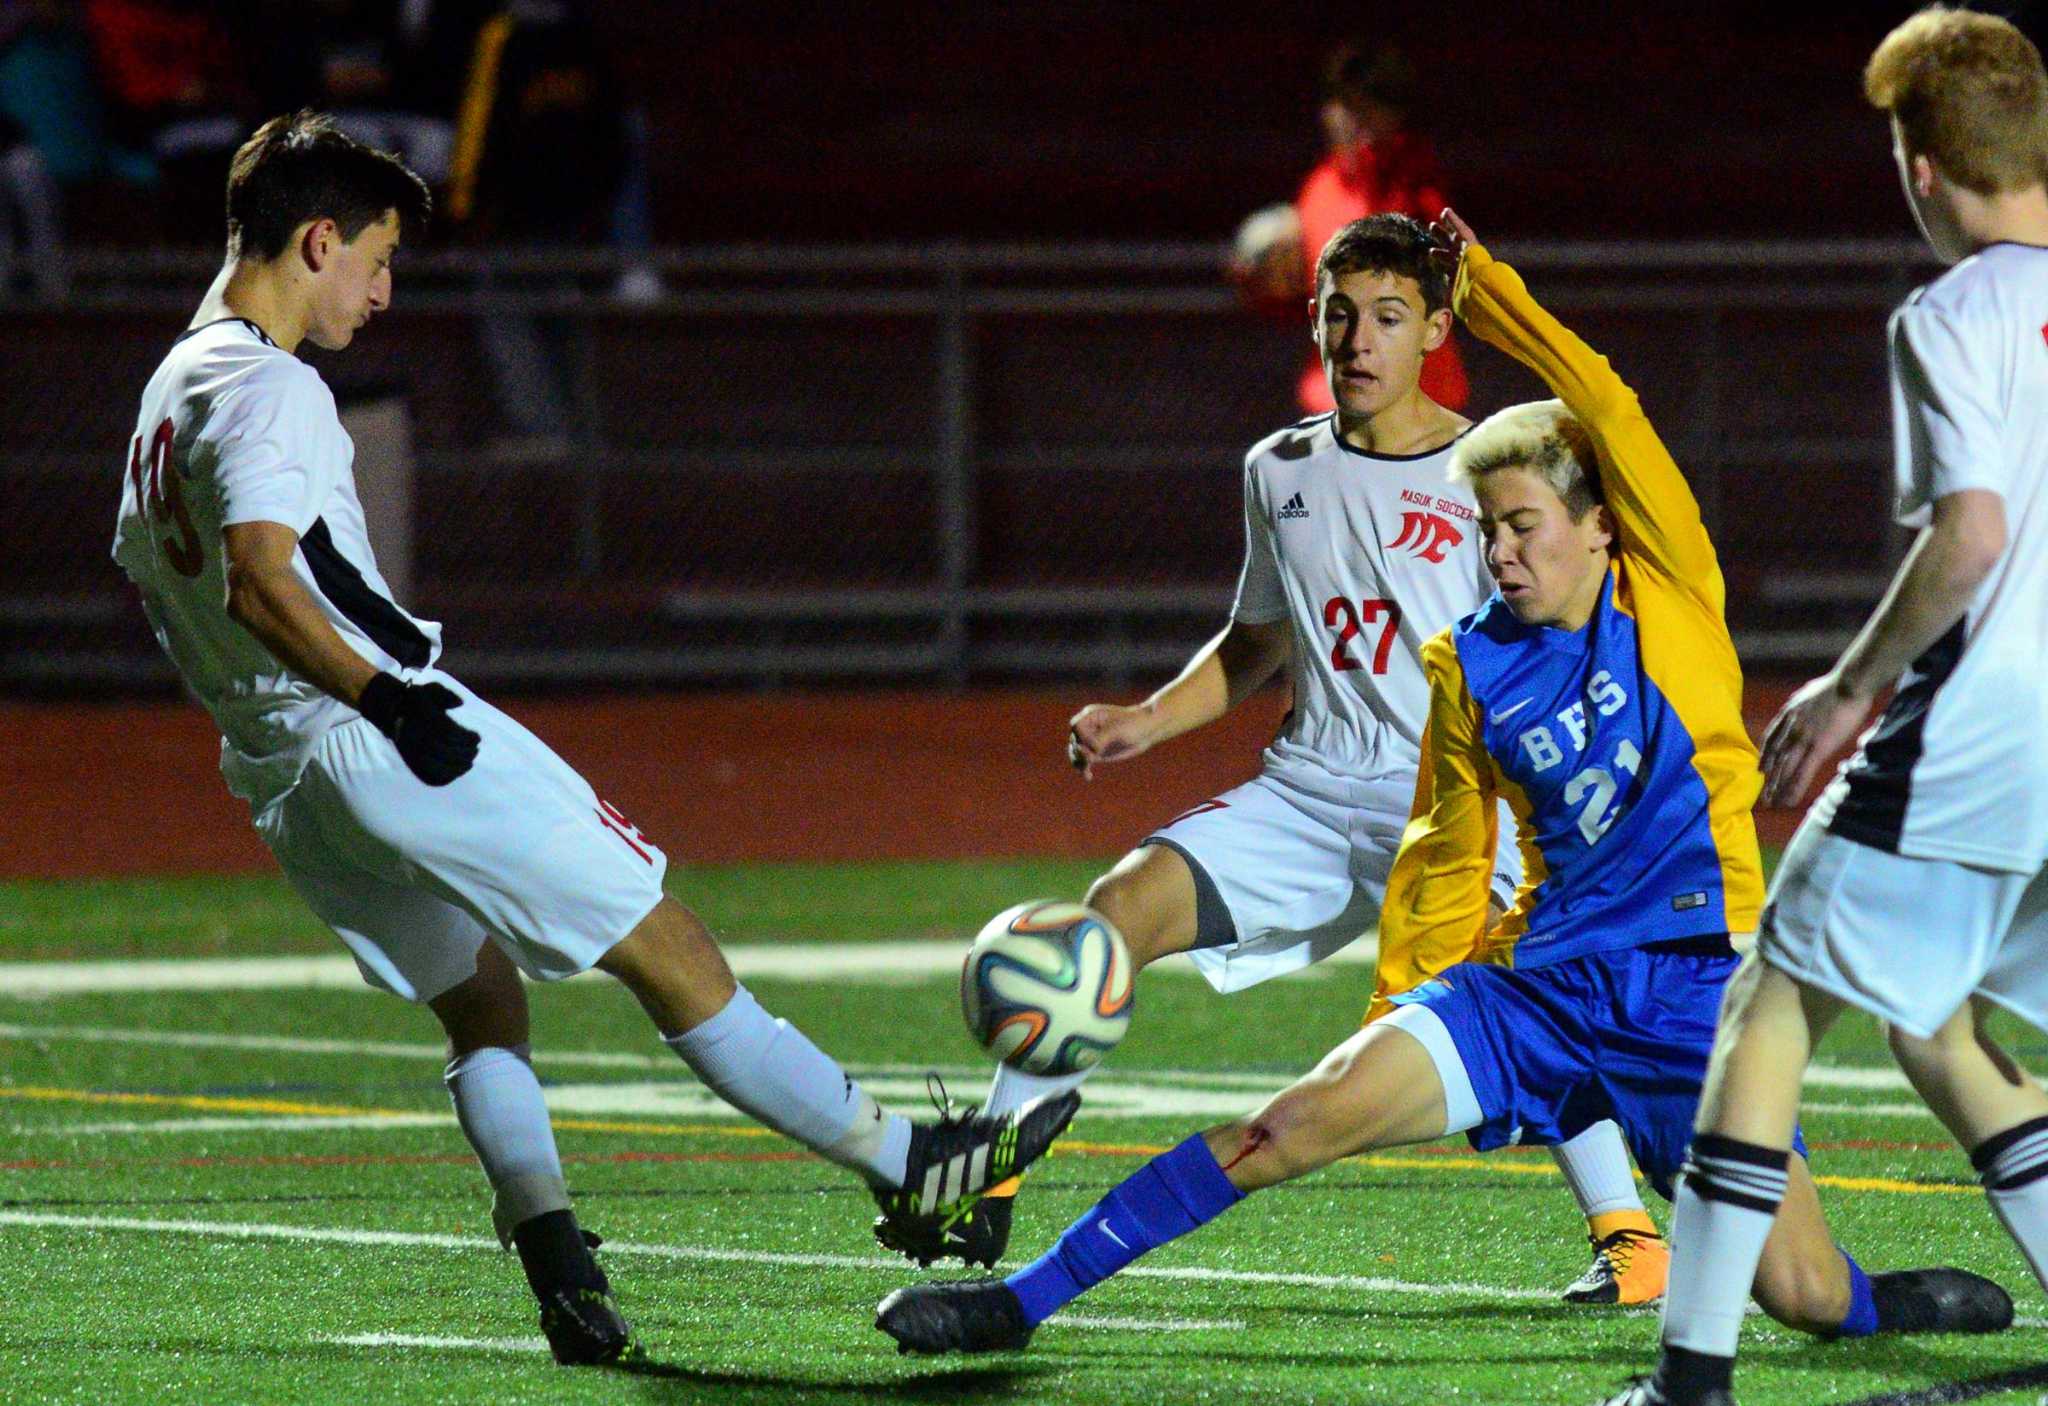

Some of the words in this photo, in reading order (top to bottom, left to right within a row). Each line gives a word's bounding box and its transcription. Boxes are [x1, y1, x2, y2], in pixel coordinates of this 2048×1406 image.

[130, 415, 205, 578] 19
[1276, 508, 1312, 520] adidas
[1400, 488, 1434, 508] MASUK
[1435, 498, 1474, 522] SOCCER
[1323, 596, 1402, 676] 27
[1563, 738, 1643, 847] 21
